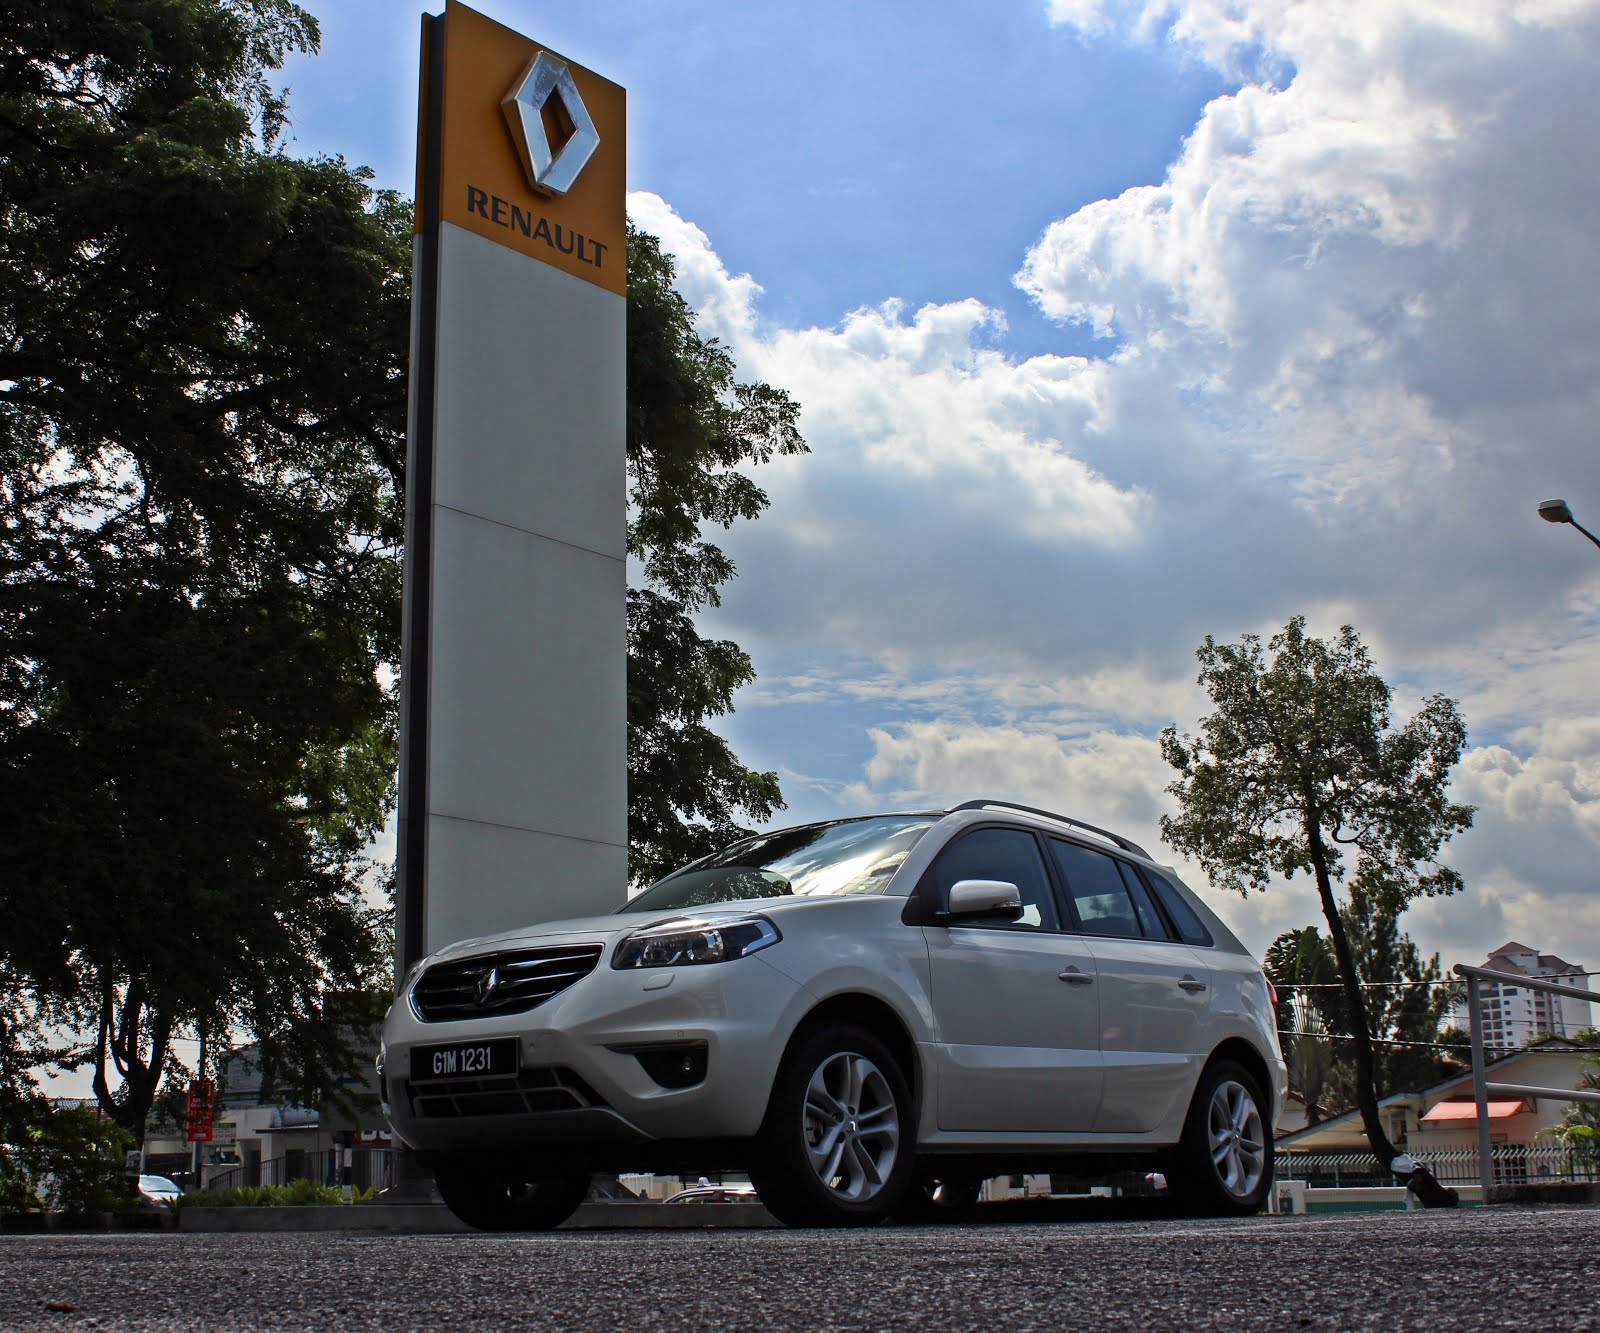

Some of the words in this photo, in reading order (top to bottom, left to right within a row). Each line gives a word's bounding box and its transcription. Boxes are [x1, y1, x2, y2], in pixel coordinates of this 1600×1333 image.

[467, 184, 608, 268] RENAULT
[433, 1050, 457, 1074] G1M
[460, 1047, 491, 1072] 1231
